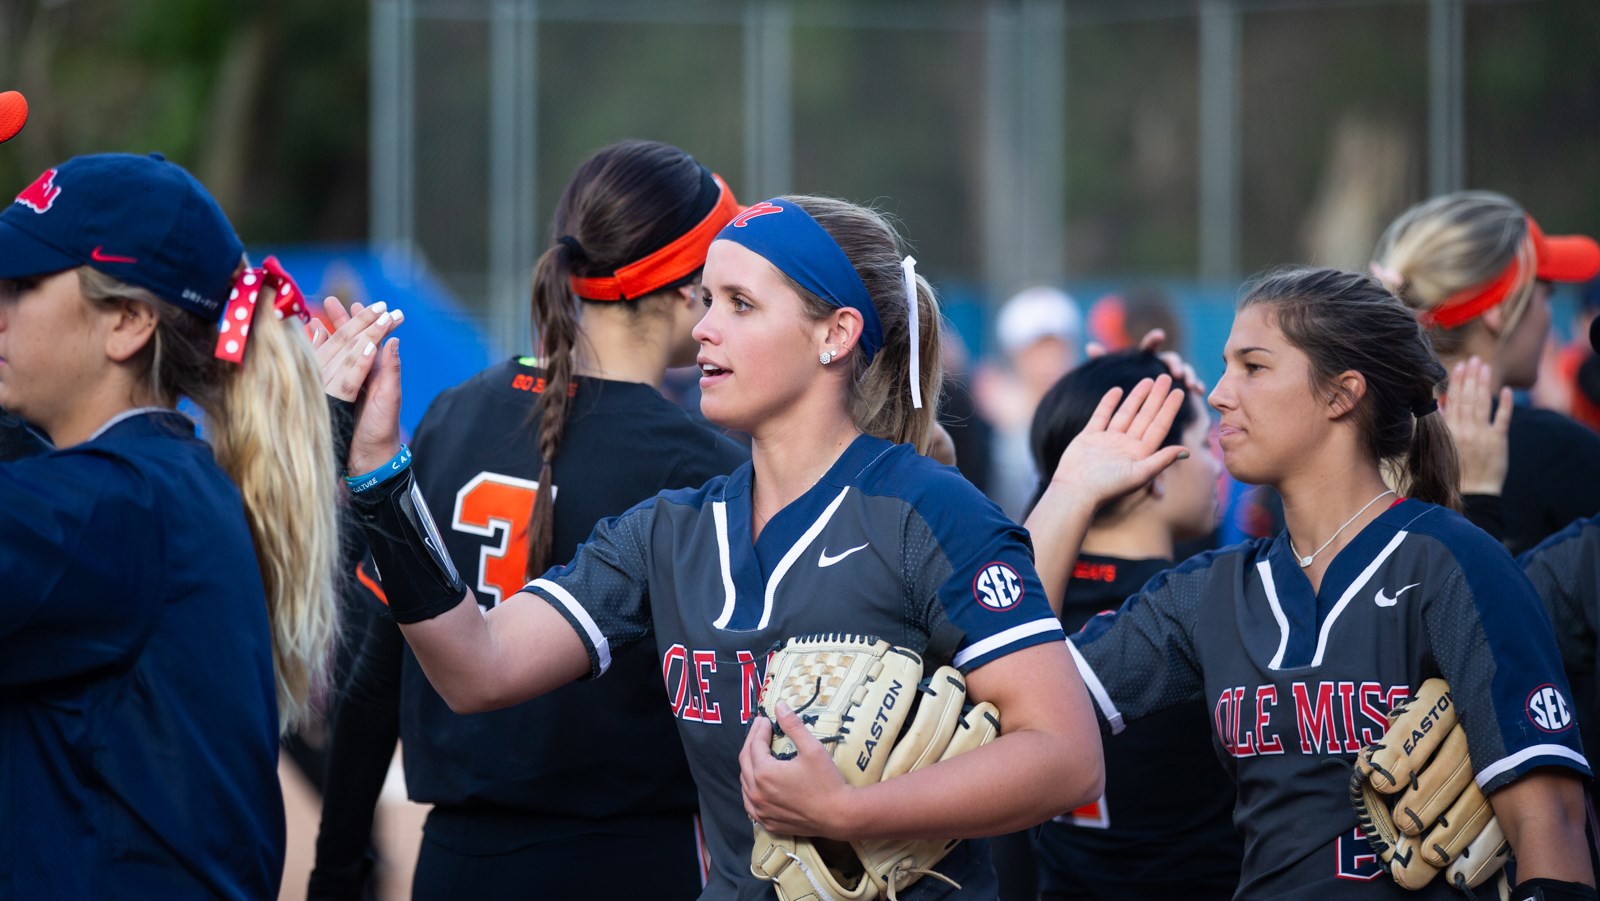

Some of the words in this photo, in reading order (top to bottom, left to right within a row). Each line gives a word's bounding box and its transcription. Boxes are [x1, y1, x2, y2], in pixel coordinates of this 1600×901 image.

[451, 471, 558, 617] 3
[977, 565, 1021, 608] SEC
[663, 643, 722, 724] OLE
[1215, 683, 1285, 758] OLE
[1529, 687, 1571, 730] SEC
[856, 679, 903, 772] EASTON
